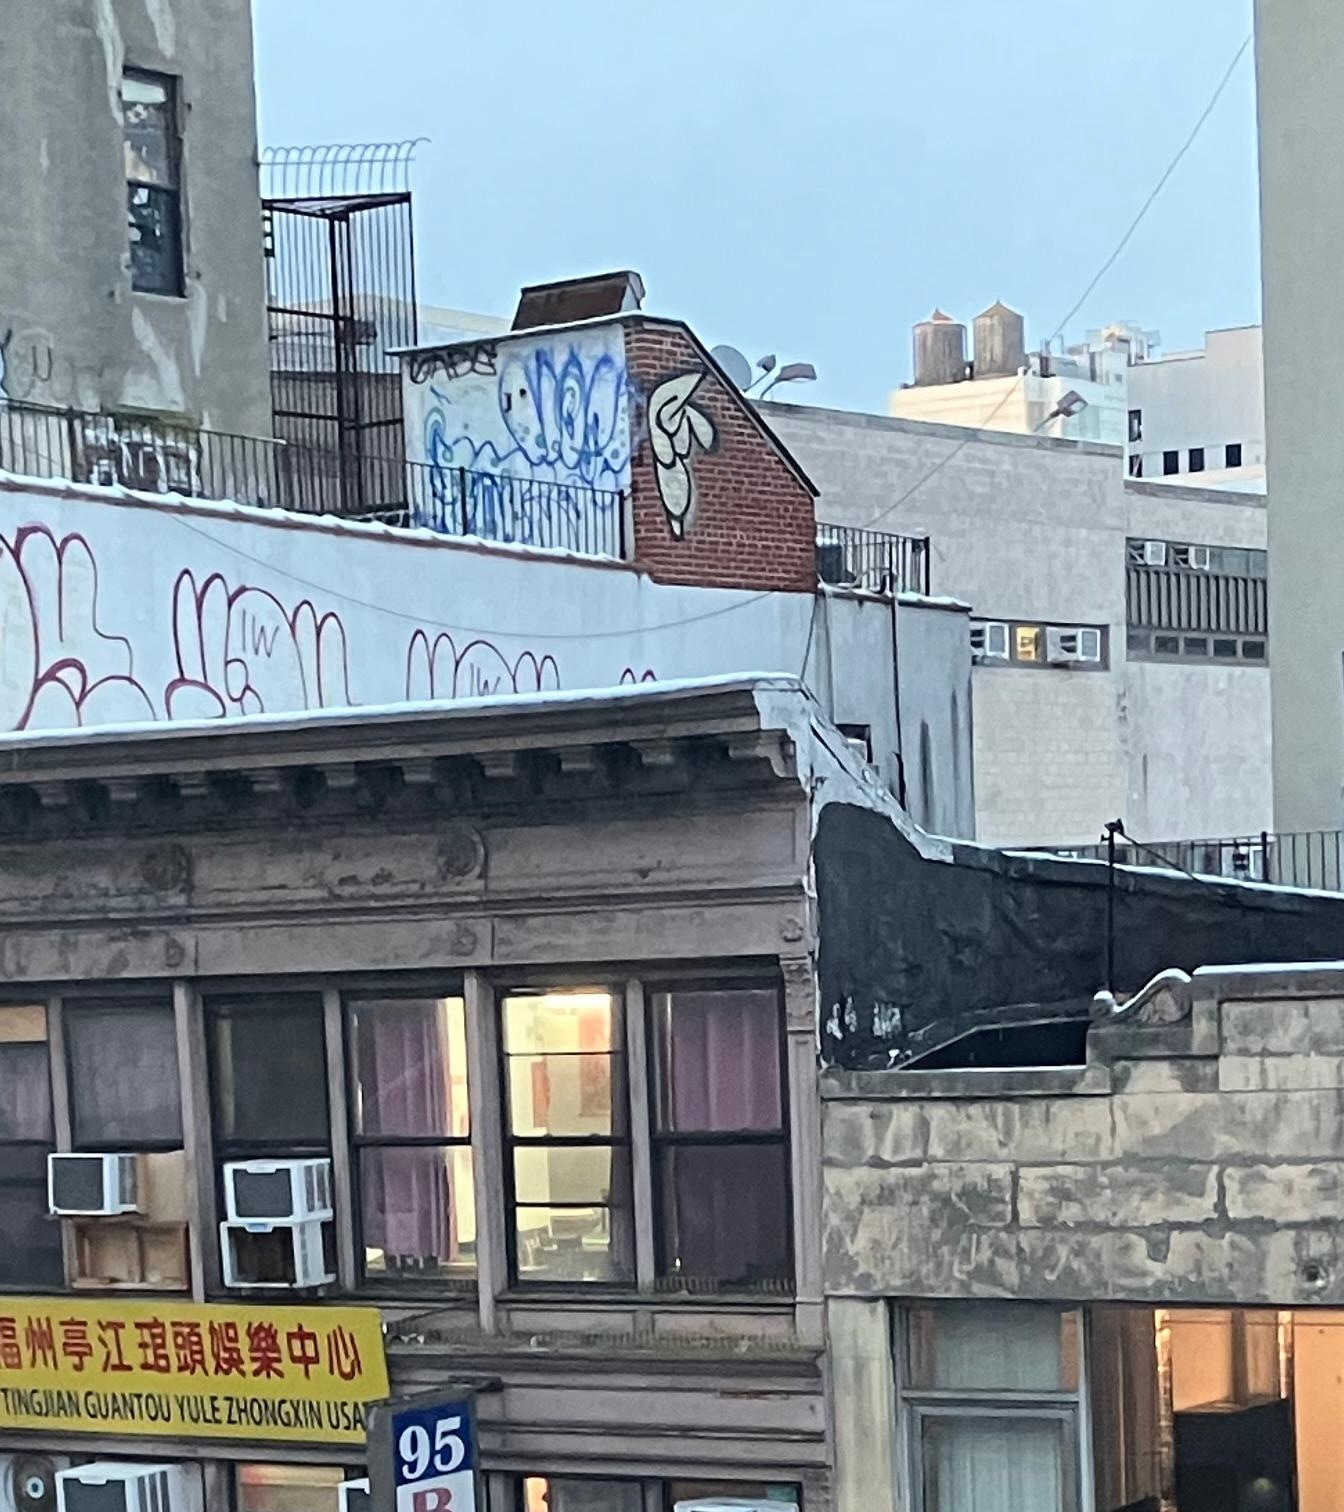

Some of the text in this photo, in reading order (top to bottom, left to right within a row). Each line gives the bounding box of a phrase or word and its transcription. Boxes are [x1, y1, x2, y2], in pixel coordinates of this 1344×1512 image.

[0, 1387, 82, 1419] TINGJIAN
[84, 1391, 172, 1423] GUANTOU
[173, 1395, 222, 1425] YULE
[226, 1396, 323, 1430] ZHONGXIN
[398, 1416, 466, 1480] 95
